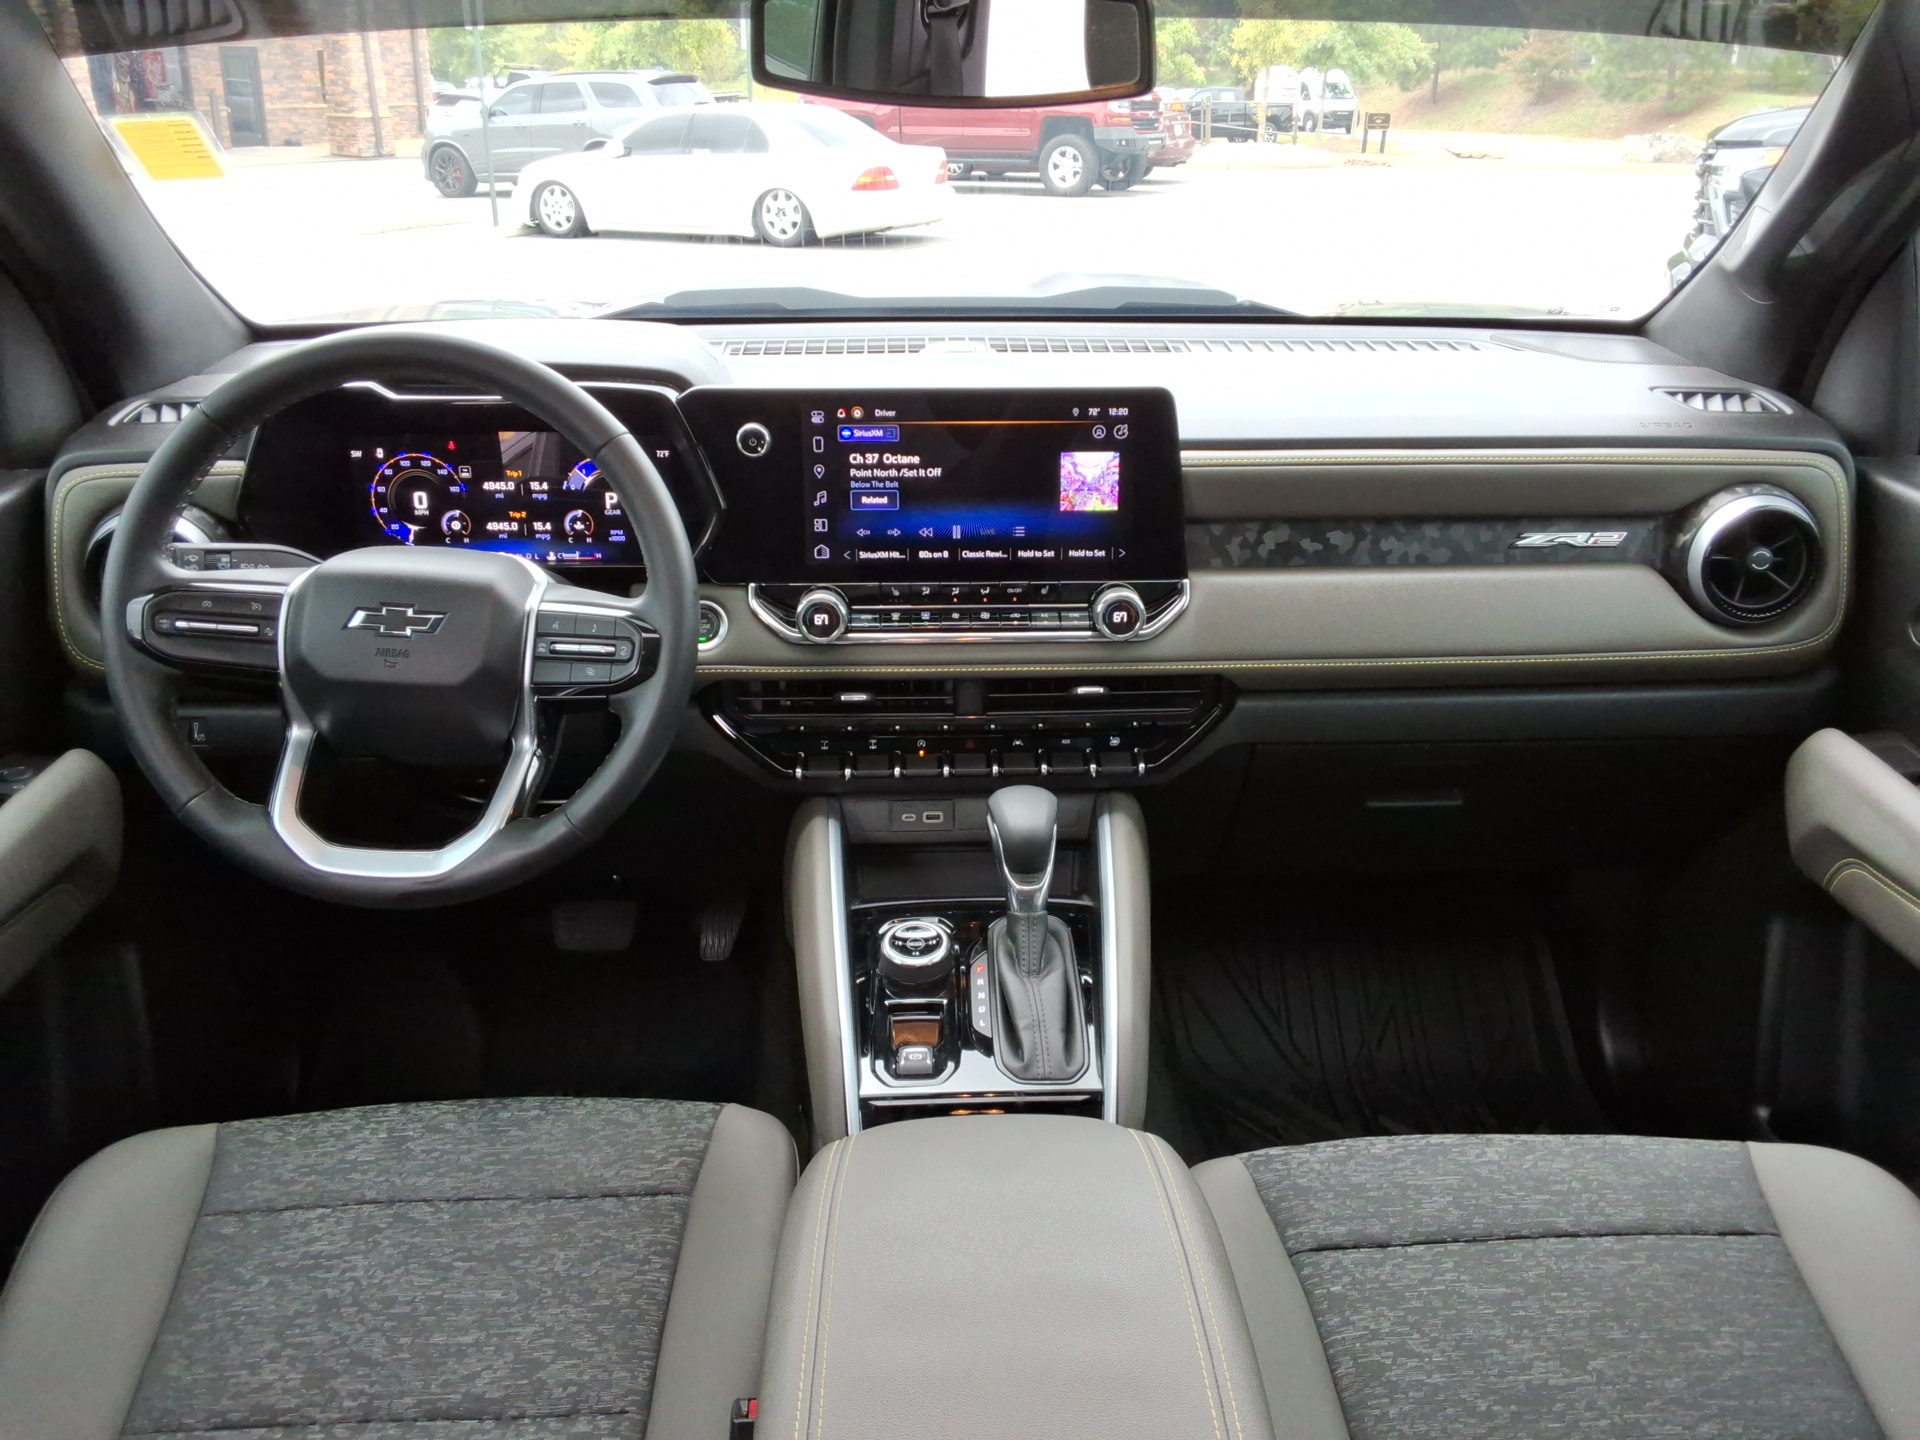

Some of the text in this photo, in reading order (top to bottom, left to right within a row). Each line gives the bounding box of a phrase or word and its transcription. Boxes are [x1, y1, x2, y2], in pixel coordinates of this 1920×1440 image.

[875, 408, 896, 417] Driver
[853, 429, 883, 437] SiriusXM
[350, 450, 362, 458] SW
[849, 453, 920, 464] Ch 37 Octane
[506, 470, 517, 478] Trip
[850, 467, 872, 477] Point
[873, 467, 898, 477] North
[919, 467, 926, 477] It
[927, 467, 942, 477] Off
[483, 481, 515, 490] 4945.0
[530, 481, 548, 490] 15.4
[850, 481, 871, 489] Below
[413, 491, 428, 508] 0
[532, 493, 548, 501] mpg
[605, 492, 618, 509] P
[861, 495, 888, 504] Related
[509, 511, 520, 519] Trip
[486, 521, 518, 531] 4945.0
[533, 521, 551, 531] 15.4
[535, 533, 551, 541] mpg
[859, 550, 889, 559] SiriusXM
[962, 550, 985, 558] Classic
[1018, 549, 1054, 558] Hold to Set
[1069, 549, 1106, 557] Hold to Set
[814, 614, 829, 625] 67
[1113, 611, 1128, 623] 67
[375, 647, 410, 658] AIRBAG
[976, 965, 984, 973] P
[978, 1005, 986, 1013] D
